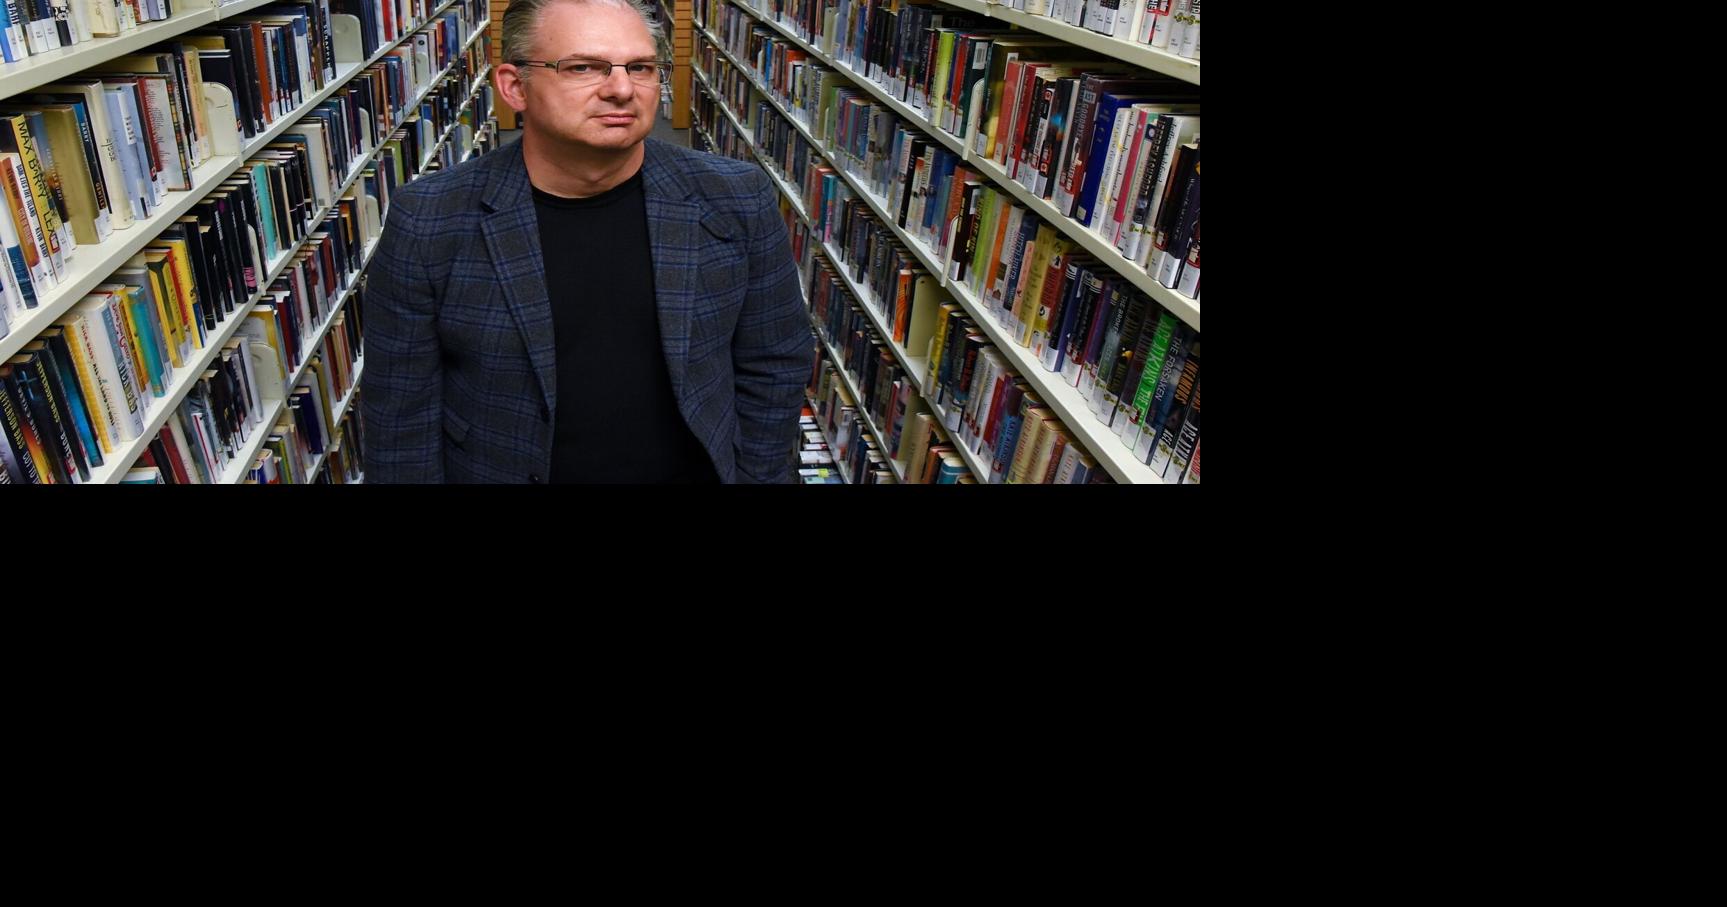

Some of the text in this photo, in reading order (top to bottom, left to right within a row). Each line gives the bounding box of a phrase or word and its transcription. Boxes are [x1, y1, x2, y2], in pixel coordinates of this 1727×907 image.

[16, 121, 35, 155] MAX
[1139, 119, 1166, 195] JEFFREY ASHFORD
[1156, 121, 1177, 183] Jeffrey Ashford
[25, 199, 36, 218] ISLAND
[34, 227, 43, 241] KEVIN
[1153, 319, 1173, 345] ACE
[115, 360, 132, 388] RICK
[1140, 341, 1167, 385] ATKINS
[1153, 335, 1181, 401] THE FORSAKEN
[34, 361, 54, 403] JEFFERSON
[49, 403, 61, 423] BASS
[1135, 387, 1151, 406] THE
[1160, 359, 1200, 445] INFAMOUS ACE
[0, 388, 18, 431] JEFFERSON
[13, 430, 26, 450] BASS
[20, 450, 34, 468] CUT
[1180, 419, 1199, 442] ACE
